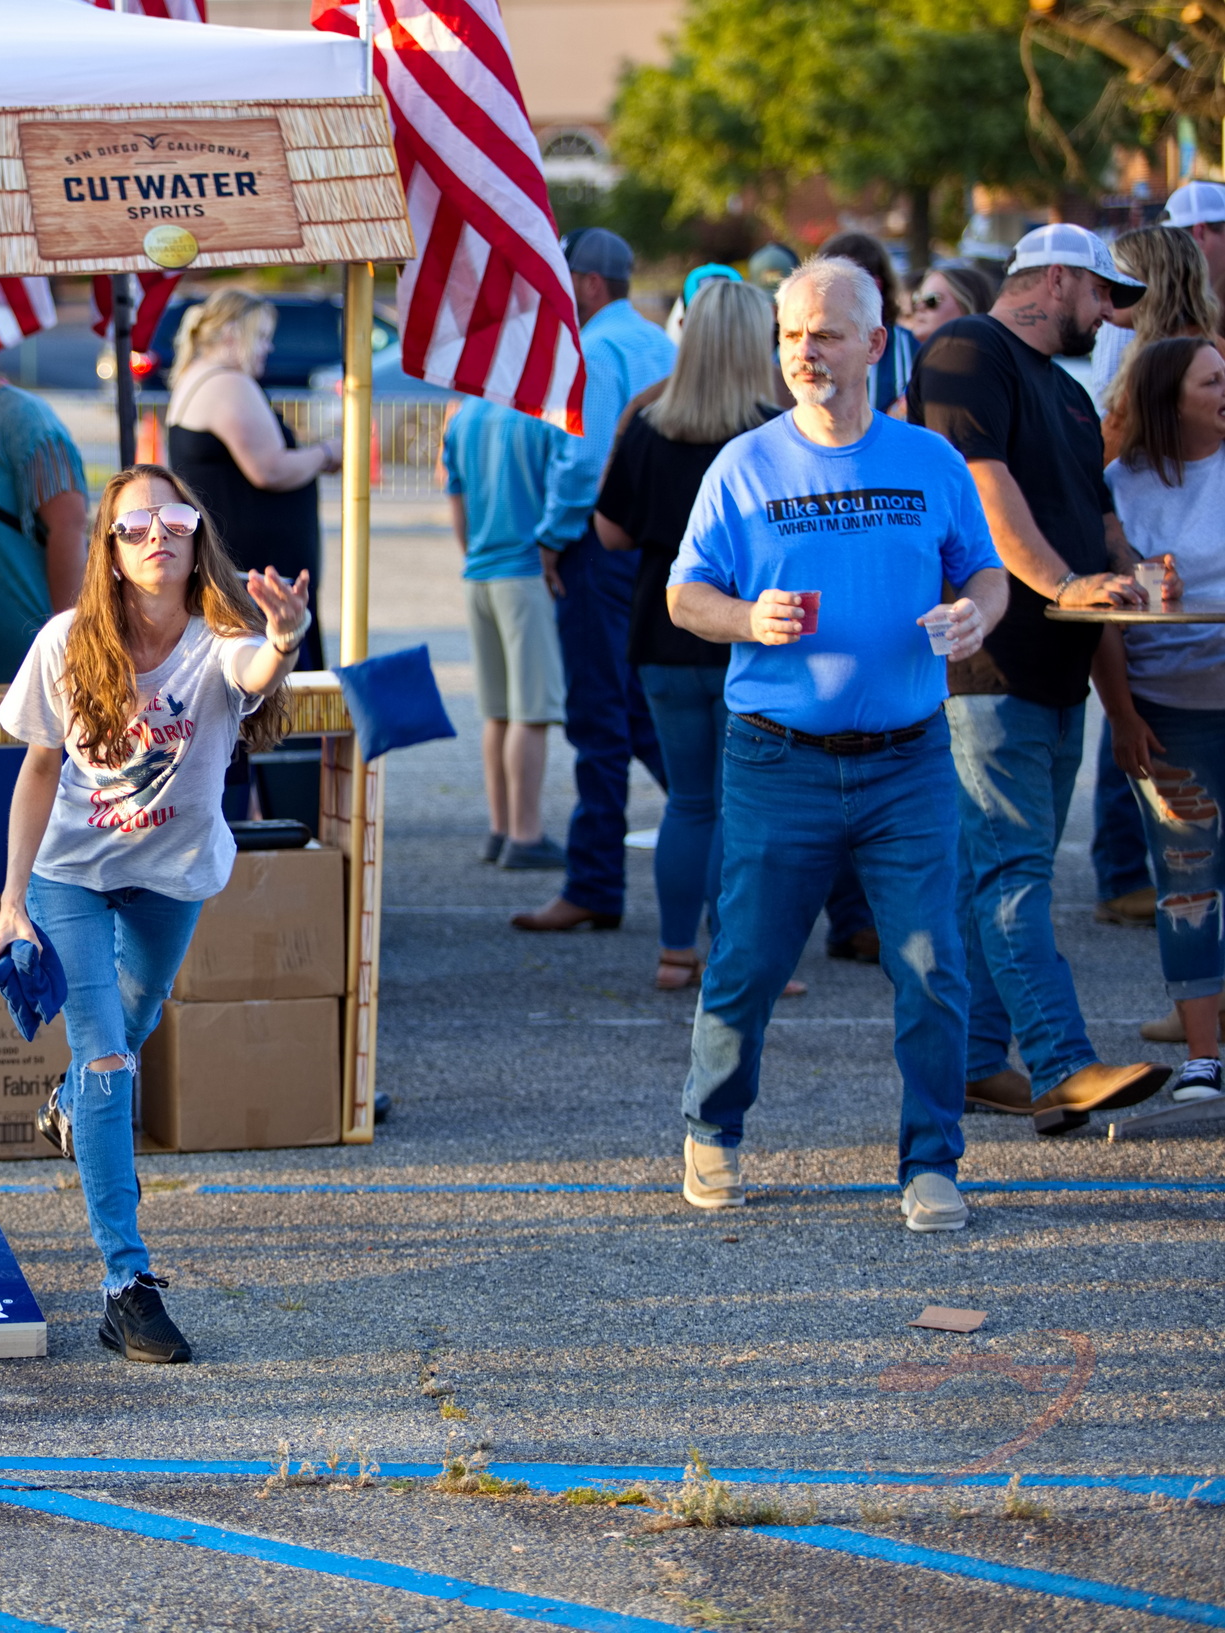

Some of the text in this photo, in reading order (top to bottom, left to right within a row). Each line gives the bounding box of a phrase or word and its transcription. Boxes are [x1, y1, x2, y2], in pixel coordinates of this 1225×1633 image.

[64, 141, 251, 165] SAN DIEGO CALIFORNIA
[63, 171, 260, 202] CUTWATER
[127, 204, 205, 220] SPIRITS
[768, 494, 924, 521] i like you more
[778, 513, 921, 537] WHEN I'M ON MY MEDS
[23, 1056, 32, 1064] of
